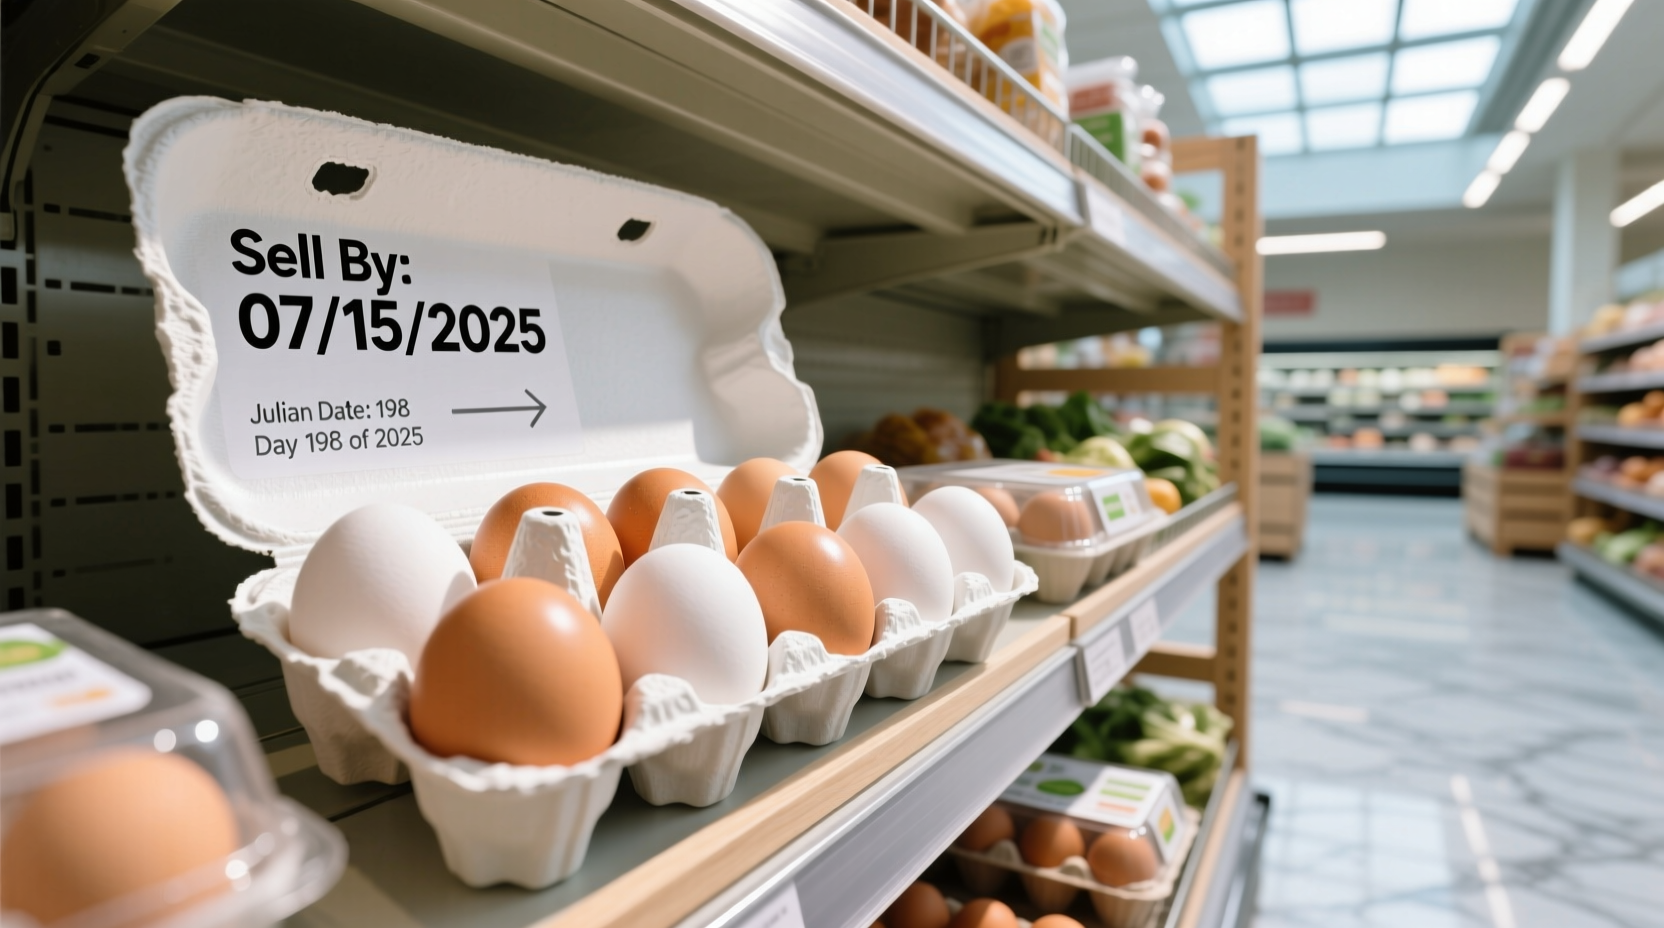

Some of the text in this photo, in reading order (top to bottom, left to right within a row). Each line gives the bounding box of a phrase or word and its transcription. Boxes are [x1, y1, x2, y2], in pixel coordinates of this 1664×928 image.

[230, 228, 412, 296] Sell By:
[238, 292, 547, 356] 07/15/2025
[250, 398, 410, 425] Julian Date: 198
[254, 426, 424, 460] Day 198 of 2025
